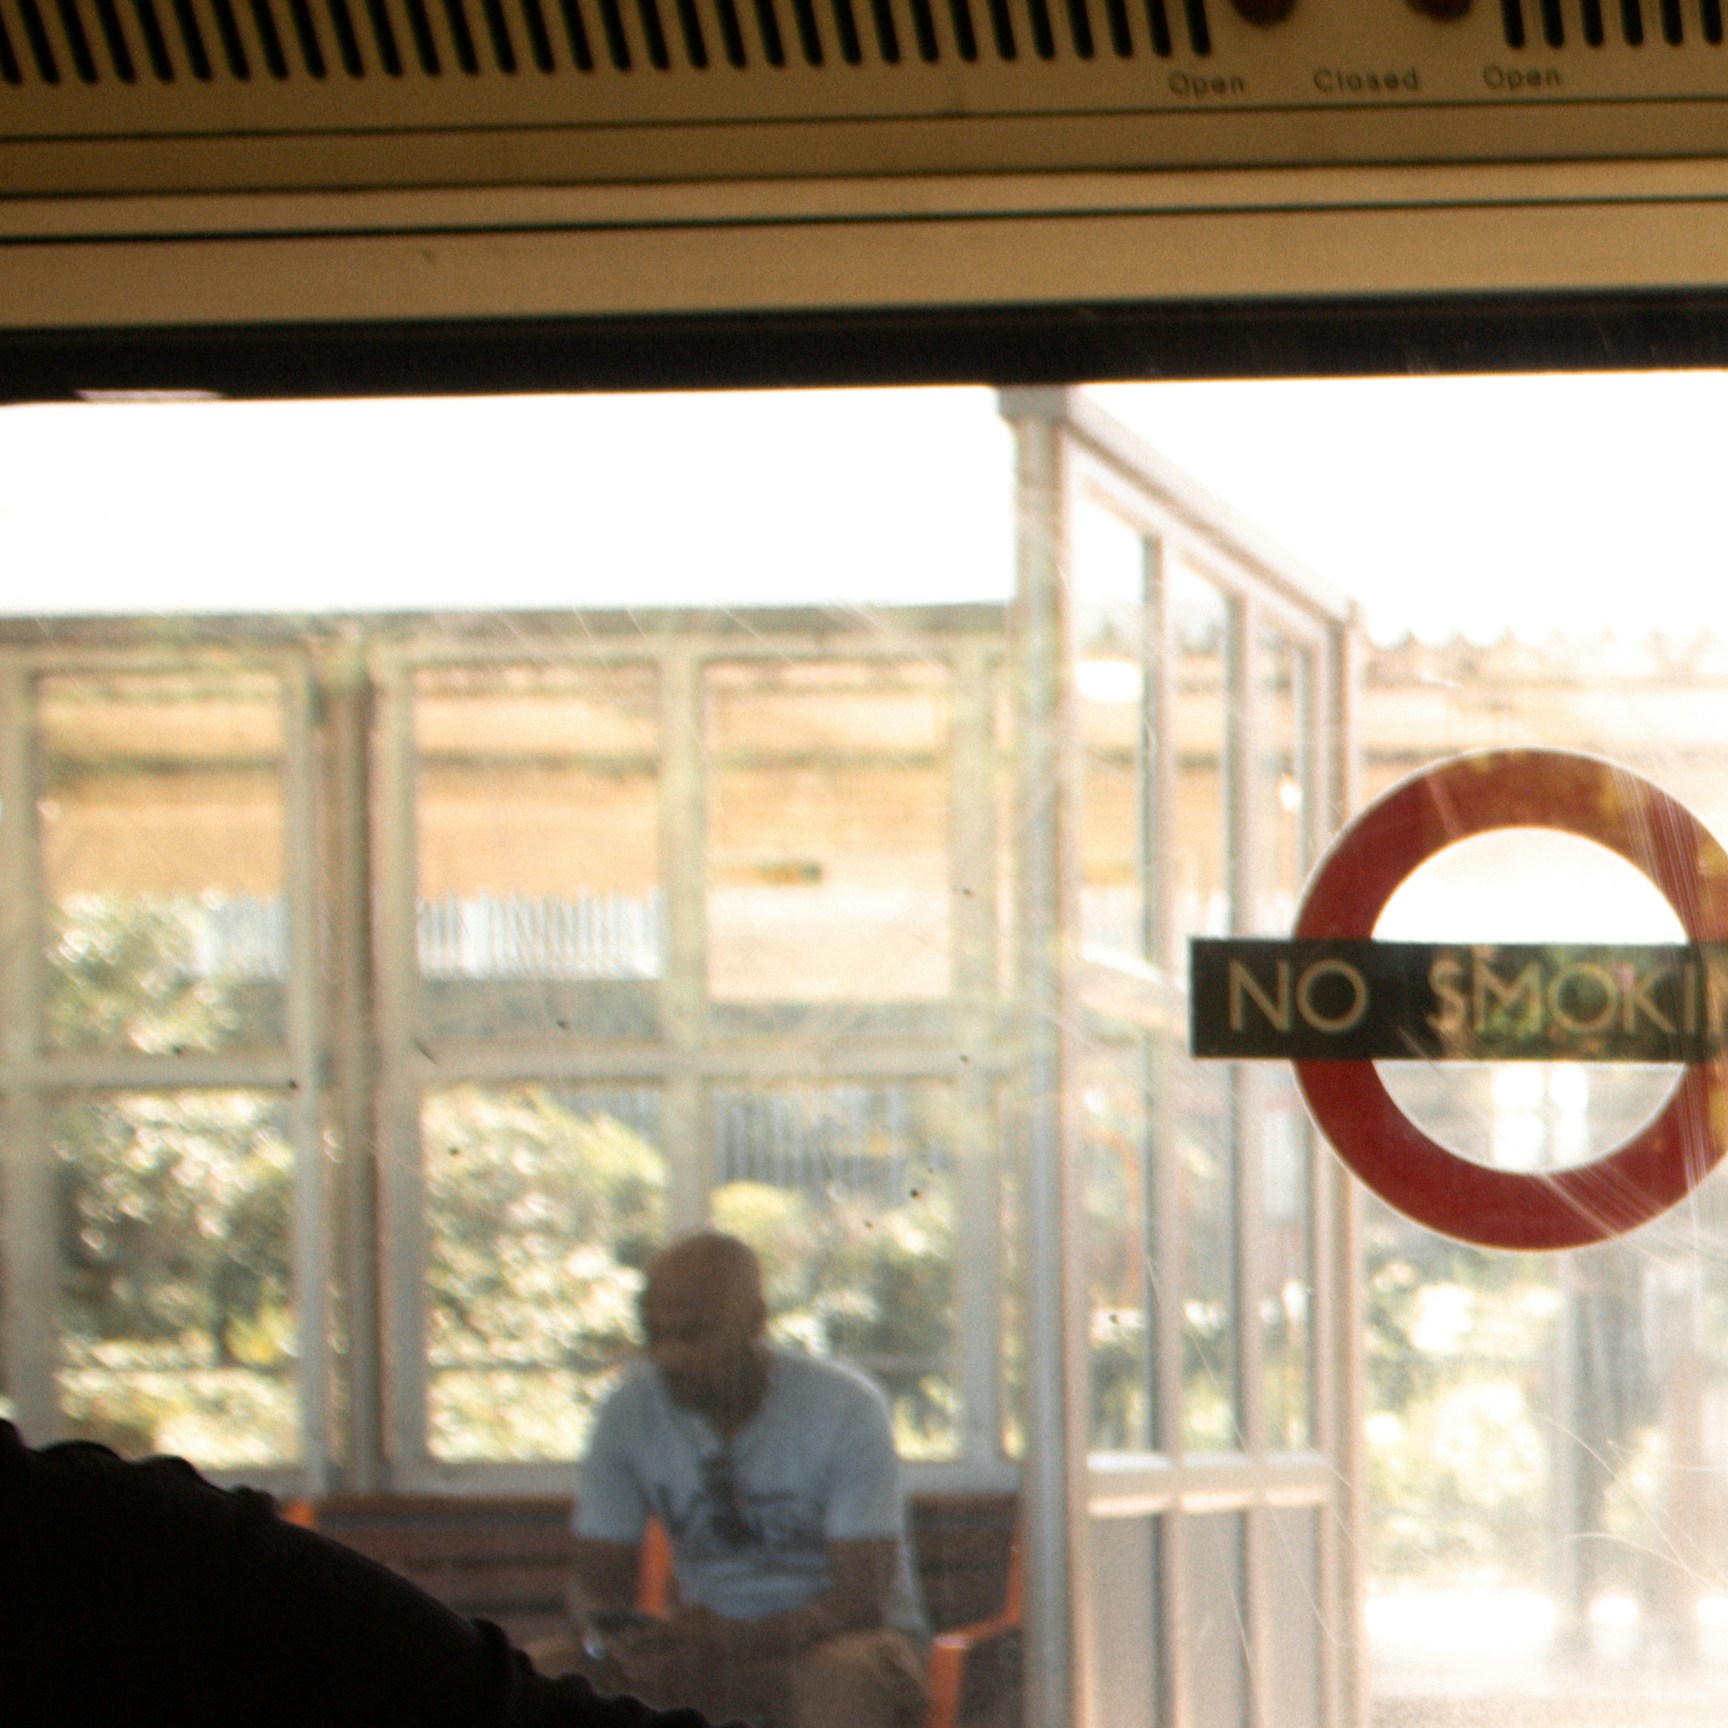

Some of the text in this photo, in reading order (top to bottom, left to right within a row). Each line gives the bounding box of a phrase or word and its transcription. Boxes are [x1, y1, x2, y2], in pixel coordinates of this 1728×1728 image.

[1168, 63, 1562, 98] Open Closed Open
[1227, 958, 1368, 1033] NO
